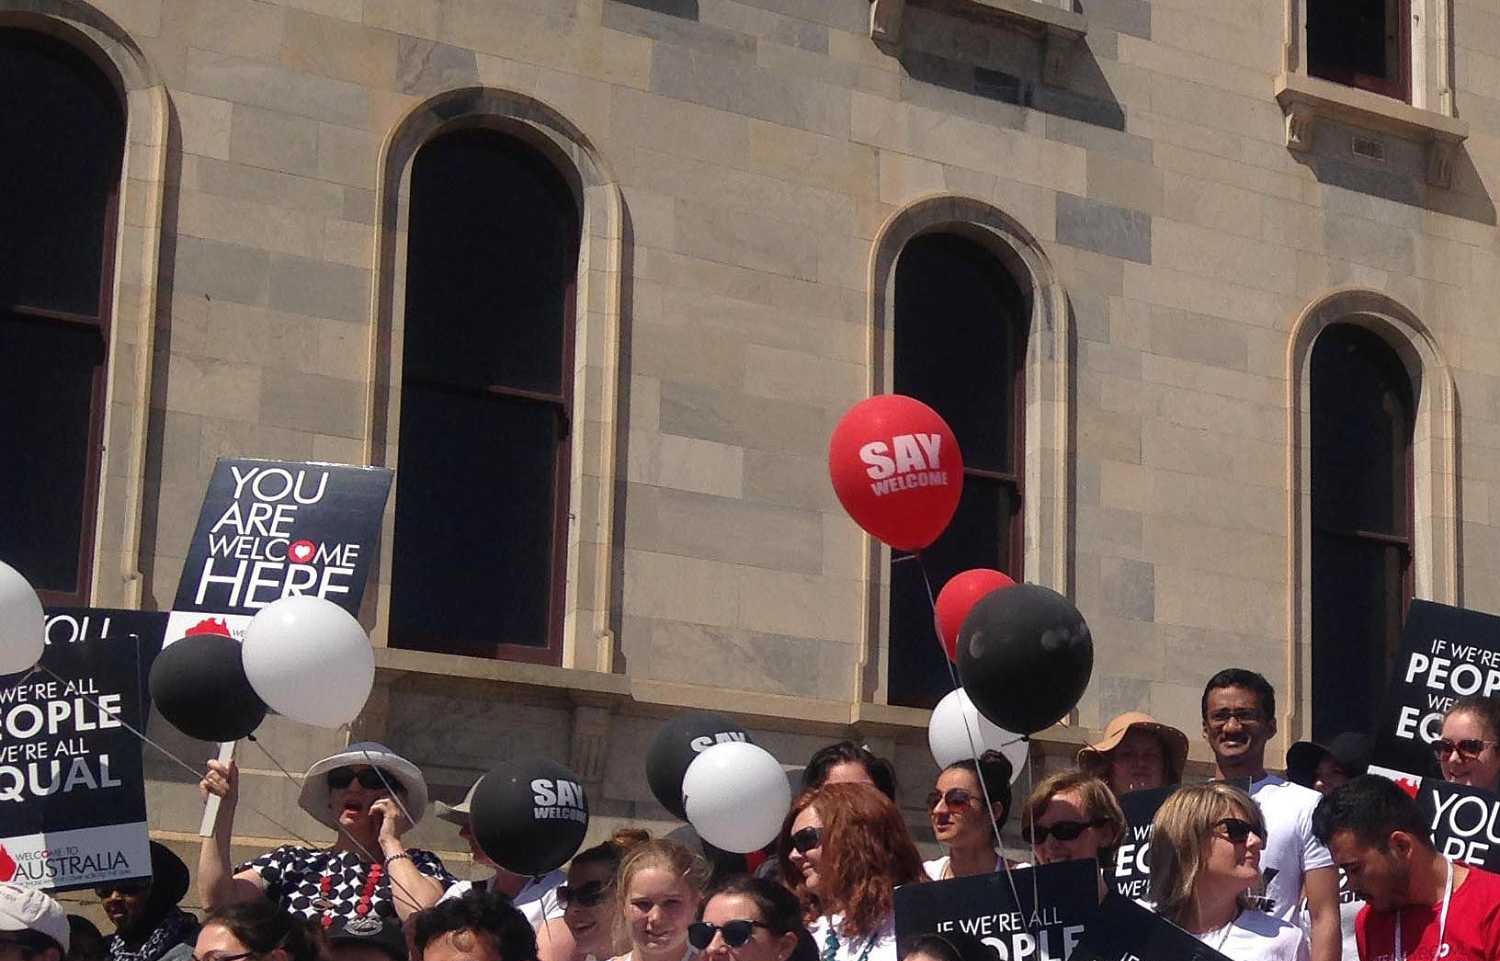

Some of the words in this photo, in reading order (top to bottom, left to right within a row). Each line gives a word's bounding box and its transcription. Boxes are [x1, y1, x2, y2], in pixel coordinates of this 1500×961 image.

[859, 433, 942, 481] SAY
[231, 466, 329, 504] YOU
[870, 471, 948, 497] WELCOME
[210, 501, 298, 538] ARE
[208, 534, 360, 567] WELCOME
[1431, 639, 1446, 654] IF
[63, 678, 99, 696] ALL
[0, 694, 123, 740] OPLE
[54, 737, 89, 757] ALL
[0, 753, 122, 802] QUAL
[530, 778, 585, 809] SAY
[13, 851, 129, 882] AUSTRALIA
[959, 912, 1022, 936] WE'RE
[1029, 907, 1063, 927] ALL
